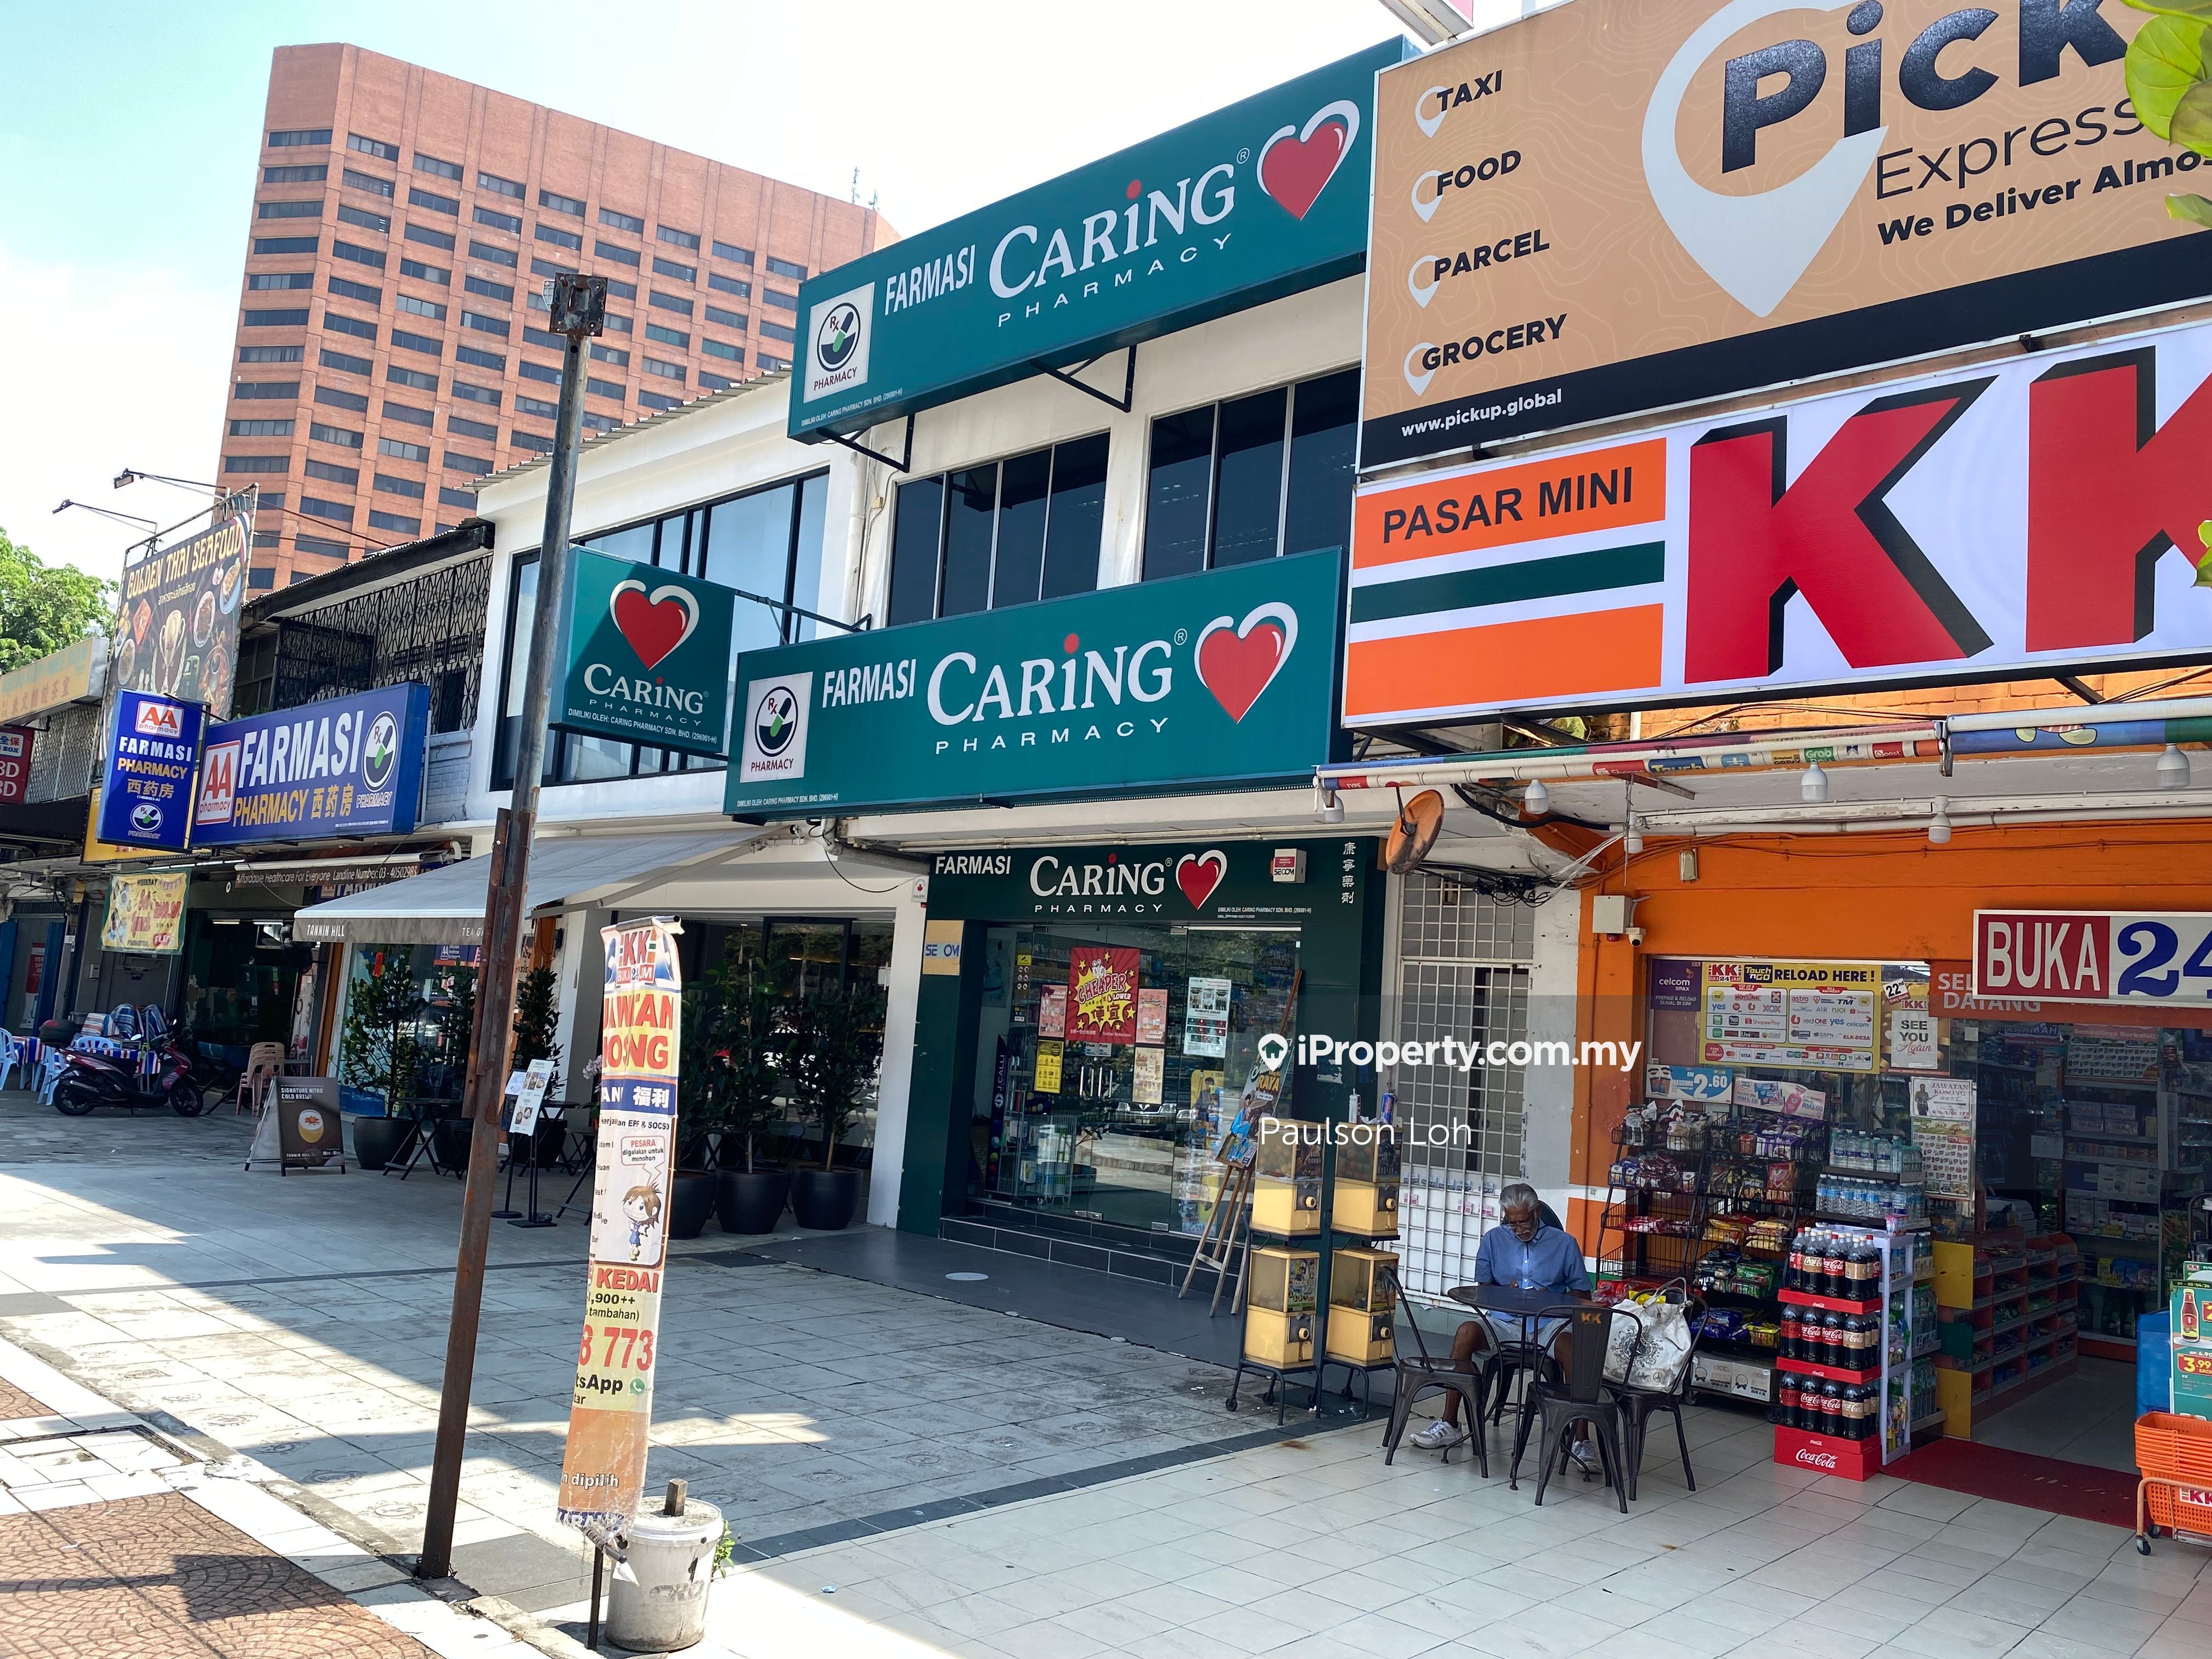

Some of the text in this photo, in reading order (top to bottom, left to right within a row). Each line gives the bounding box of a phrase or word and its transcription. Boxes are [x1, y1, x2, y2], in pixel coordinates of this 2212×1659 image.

[1437, 70, 1503, 112] TAXI
[1877, 98, 2144, 200] Express
[1437, 150, 1521, 196] FOOD
[1878, 151, 2212, 245] We Deliver Almo
[1434, 229, 1550, 282] PARCEL
[885, 244, 974, 315] FARMASI
[998, 233, 1232, 327] PHARMACY
[1422, 313, 1567, 370] GROCERY
[814, 367, 857, 391] PHARMACY
[802, 416, 815, 426] DIMILIKI
[816, 414, 827, 423] OLEH:
[827, 408, 842, 418] CARING
[842, 402, 863, 413] PHARMACY
[1402, 388, 1562, 437] www.pickup.global
[1384, 466, 1632, 544] PASAR MINI
[1685, 346, 2212, 684] KK
[127, 523, 242, 599] GOLDEN THAI SEAFOOD
[822, 659, 916, 708] FARMASI
[141, 707, 177, 729] AA
[589, 699, 701, 726] PHARMACY
[139, 724, 178, 734] pharmacy
[568, 708, 716, 743] DIMILIKI OLEH: CARING PHARMACY SDN. BHD. (296901-H)
[935, 718, 1168, 754] PHARMACY
[119, 736, 192, 761] FARMASI
[238, 710, 364, 788] FARMASI
[1806, 748, 1831, 757] Grab
[117, 758, 188, 780] PHARMACY
[751, 758, 794, 772] PHARMACY
[202, 753, 231, 800] AA
[127, 778, 174, 799] 西药房
[356, 791, 392, 808] PHARMACY
[200, 799, 231, 815] pharmacy
[233, 782, 354, 827] PHARMACY 西药房
[778, 796, 799, 804] PHARMACY
[128, 831, 161, 839] PHARMACY
[235, 872, 264, 883] Affordable
[265, 871, 294, 883] Healthcare
[295, 871, 304, 882] For
[306, 871, 331, 883] Everyone
[333, 868, 354, 881] Landline
[379, 867, 386, 878] 03
[935, 856, 1011, 874] FARMASI
[1035, 904, 1163, 913] PHARMACY
[307, 925, 345, 937] TANNIN HILL
[623, 929, 651, 966] KK
[1987, 922, 2100, 991] BUKA
[1712, 964, 1737, 975] KK
[1774, 968, 1867, 982] RELOAD HERE
[1077, 973, 1126, 1004] CHEAPER
[1659, 978, 1690, 986] celcom
[1113, 993, 1131, 1001] LOWER
[1905, 1000, 1924, 1008] KK
[1091, 1002, 1120, 1022] 便宜
[1901, 1020, 1927, 1030] SEE
[1899, 1032, 1928, 1042] YOU
[1896, 1041, 1932, 1056] Again
[1257, 1075, 1280, 1091] RAYA
[633, 1086, 669, 1108] 福利
[623, 1148, 646, 1156] digalakan
[596, 1268, 659, 1293] KEDAI
[589, 1307, 639, 1322] tambahan)
[1582, 1312, 1602, 1324] KK
[603, 1327, 653, 1371] 773
[571, 1472, 619, 1489] dipilih
